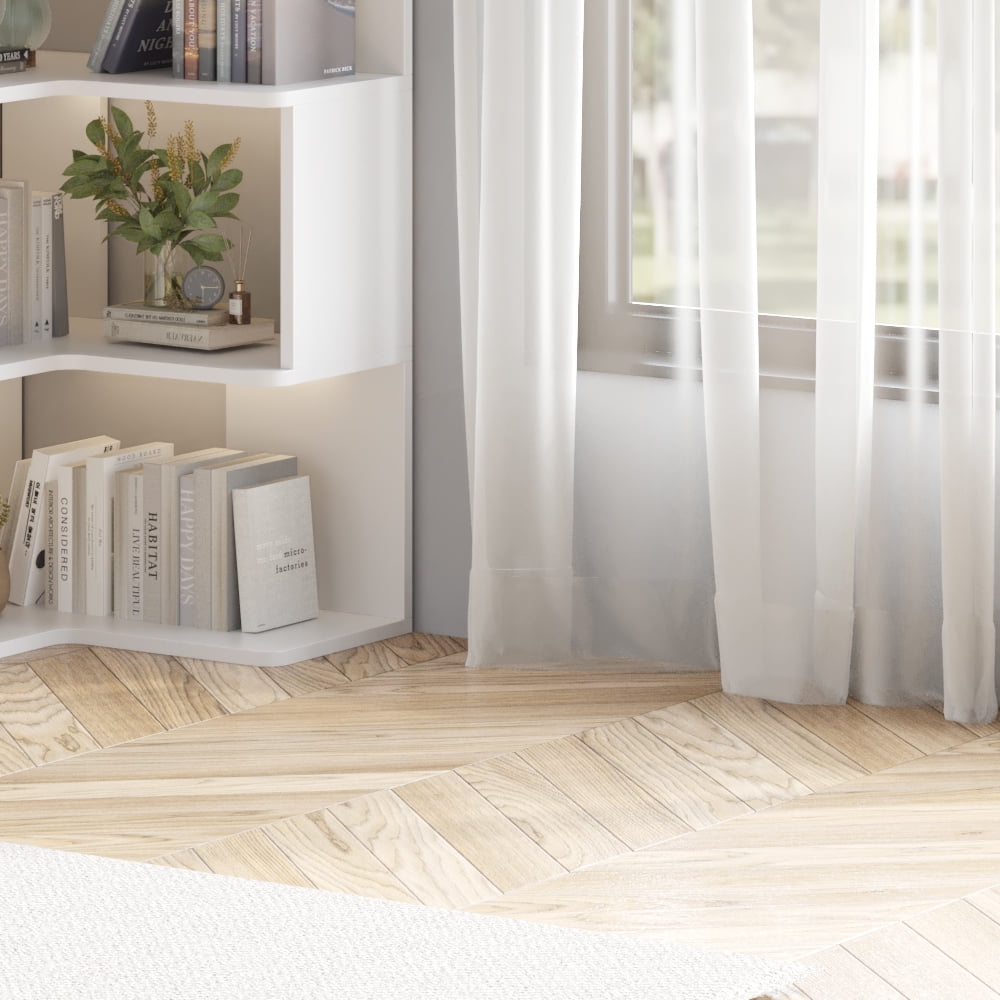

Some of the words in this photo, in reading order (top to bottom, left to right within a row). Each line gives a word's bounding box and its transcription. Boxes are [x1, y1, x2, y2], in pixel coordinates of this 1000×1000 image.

[137, 36, 173, 53] NIGH
[249, 9, 257, 53] VACATION
[3, 51, 21, 61] YEARS
[60, 497, 69, 582] CONSIDERED
[131, 528, 140, 553] LIVE
[180, 488, 195, 552] HAPPY
[148, 512, 158, 581] HABITAT
[275, 561, 308, 574] factories
[283, 548, 307, 558] micro-
[131, 555, 140, 616] BEAUTIFUL
[180, 558, 195, 605] DAYS
